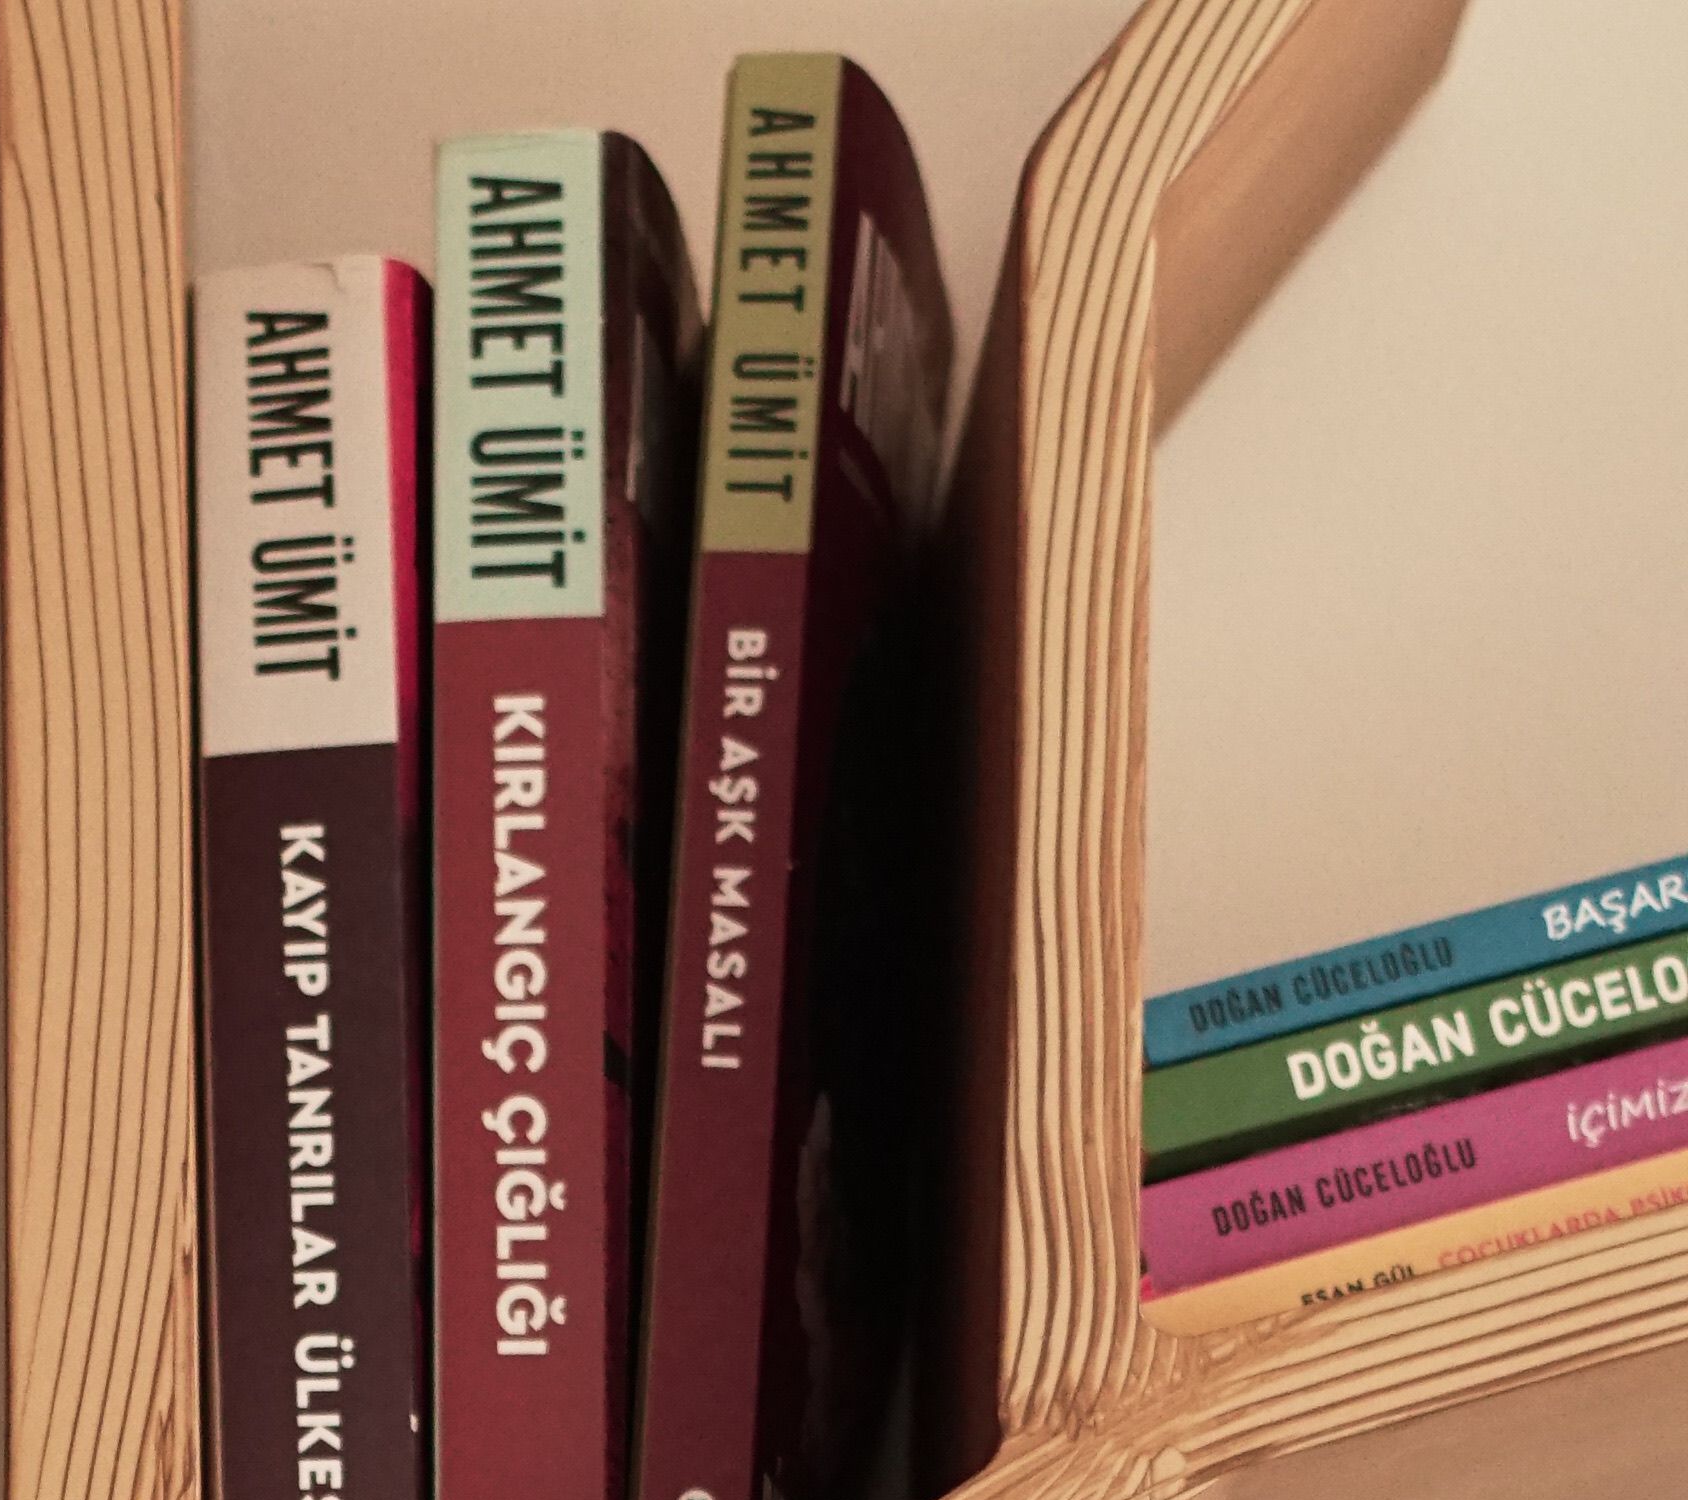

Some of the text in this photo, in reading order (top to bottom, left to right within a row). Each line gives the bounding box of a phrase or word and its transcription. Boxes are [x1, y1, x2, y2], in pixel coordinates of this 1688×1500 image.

[469, 174, 585, 588] AHMET ÜMİT
[724, 107, 816, 503] AHMET ÜMİT
[245, 311, 357, 682] AHMET ÜMİT
[279, 823, 331, 999] KAYIP
[482, 693, 568, 1358] KIRLANGIÇ ÇIĞLIĞI
[701, 628, 779, 1070] BİR AŞK MASALI
[1286, 955, 1688, 1099] DOĞAN CÜCELO
[284, 1013, 336, 1310] TANRILAR
[1212, 1138, 1476, 1237] DOĞAN CÜCELOĞLU
